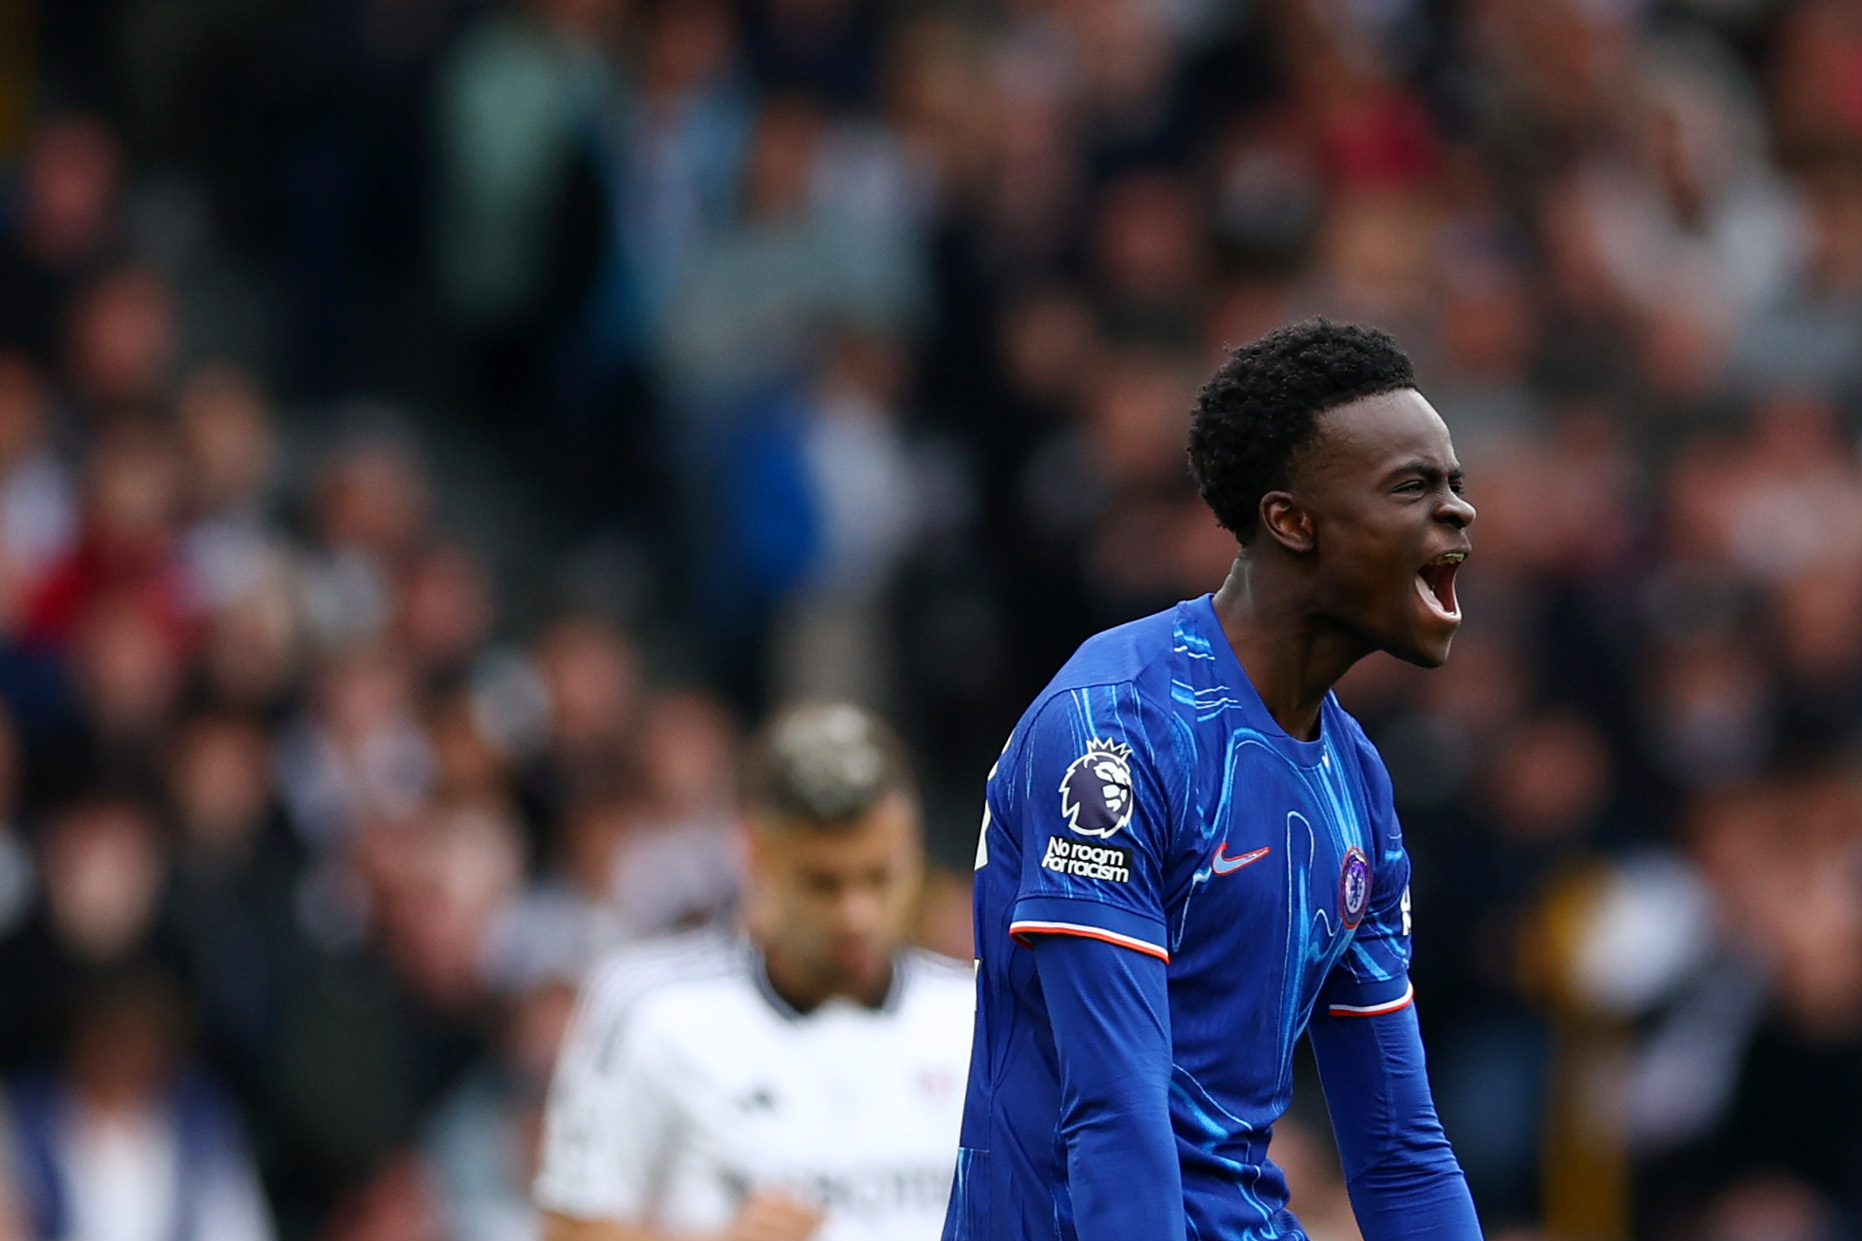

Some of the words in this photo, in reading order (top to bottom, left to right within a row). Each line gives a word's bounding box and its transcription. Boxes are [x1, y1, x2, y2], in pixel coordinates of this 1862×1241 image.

[1047, 836, 1070, 857] No
[1071, 844, 1124, 866] room
[1067, 859, 1130, 883] racism
